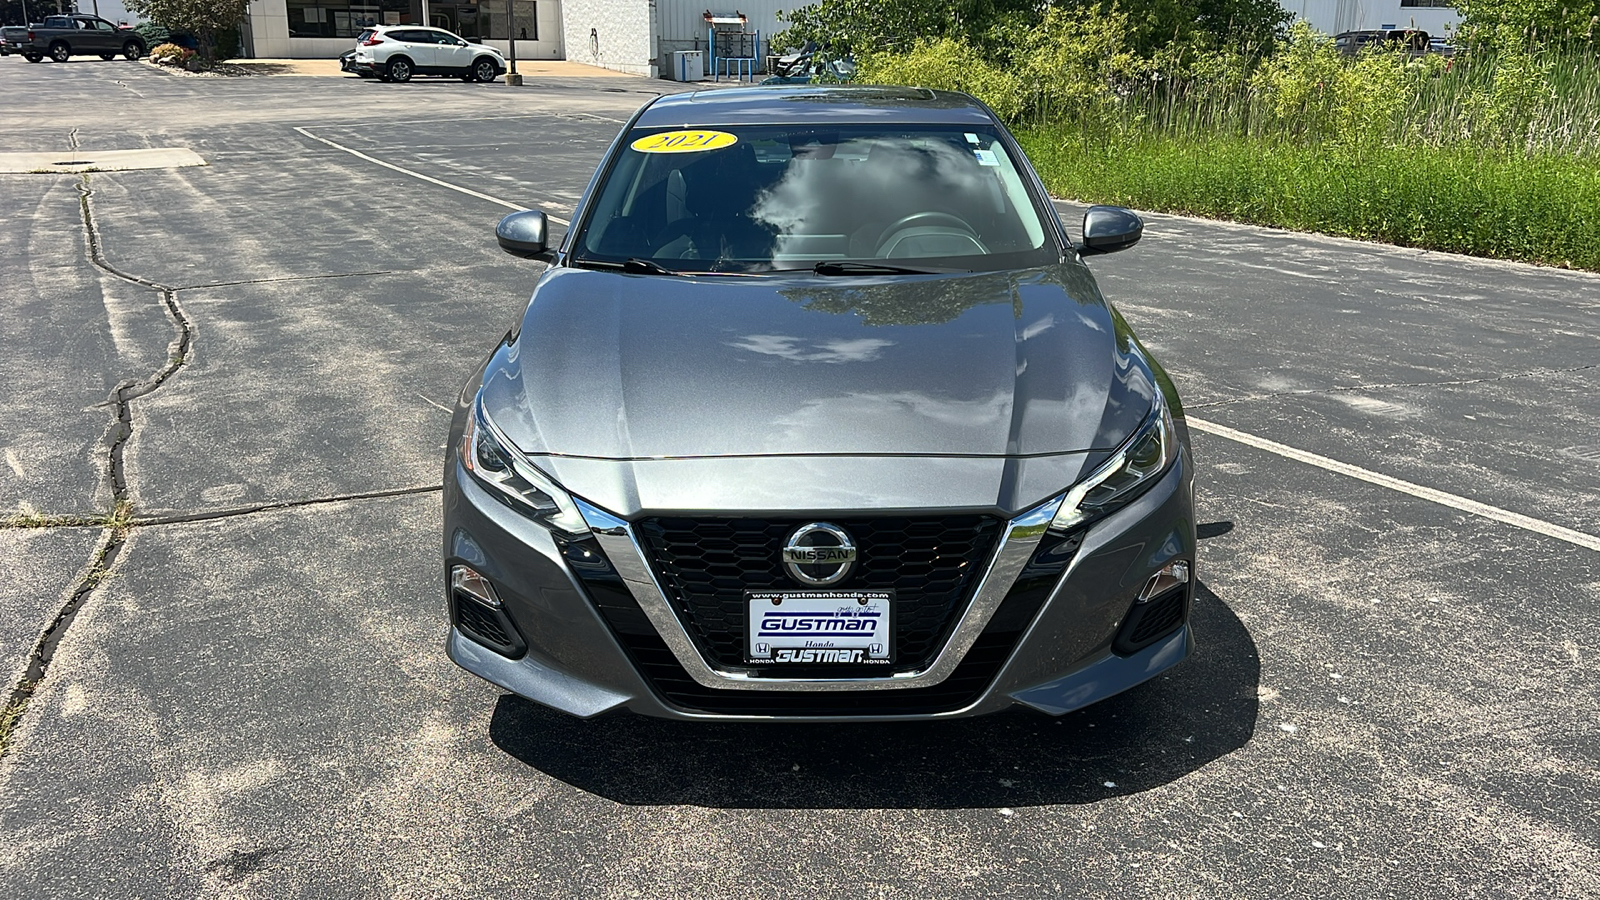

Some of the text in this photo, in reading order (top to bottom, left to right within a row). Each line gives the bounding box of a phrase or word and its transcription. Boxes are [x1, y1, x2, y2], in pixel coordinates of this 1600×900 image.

[648, 134, 719, 149] 2021
[791, 550, 849, 560] NISSAN
[805, 640, 835, 648] Honda
